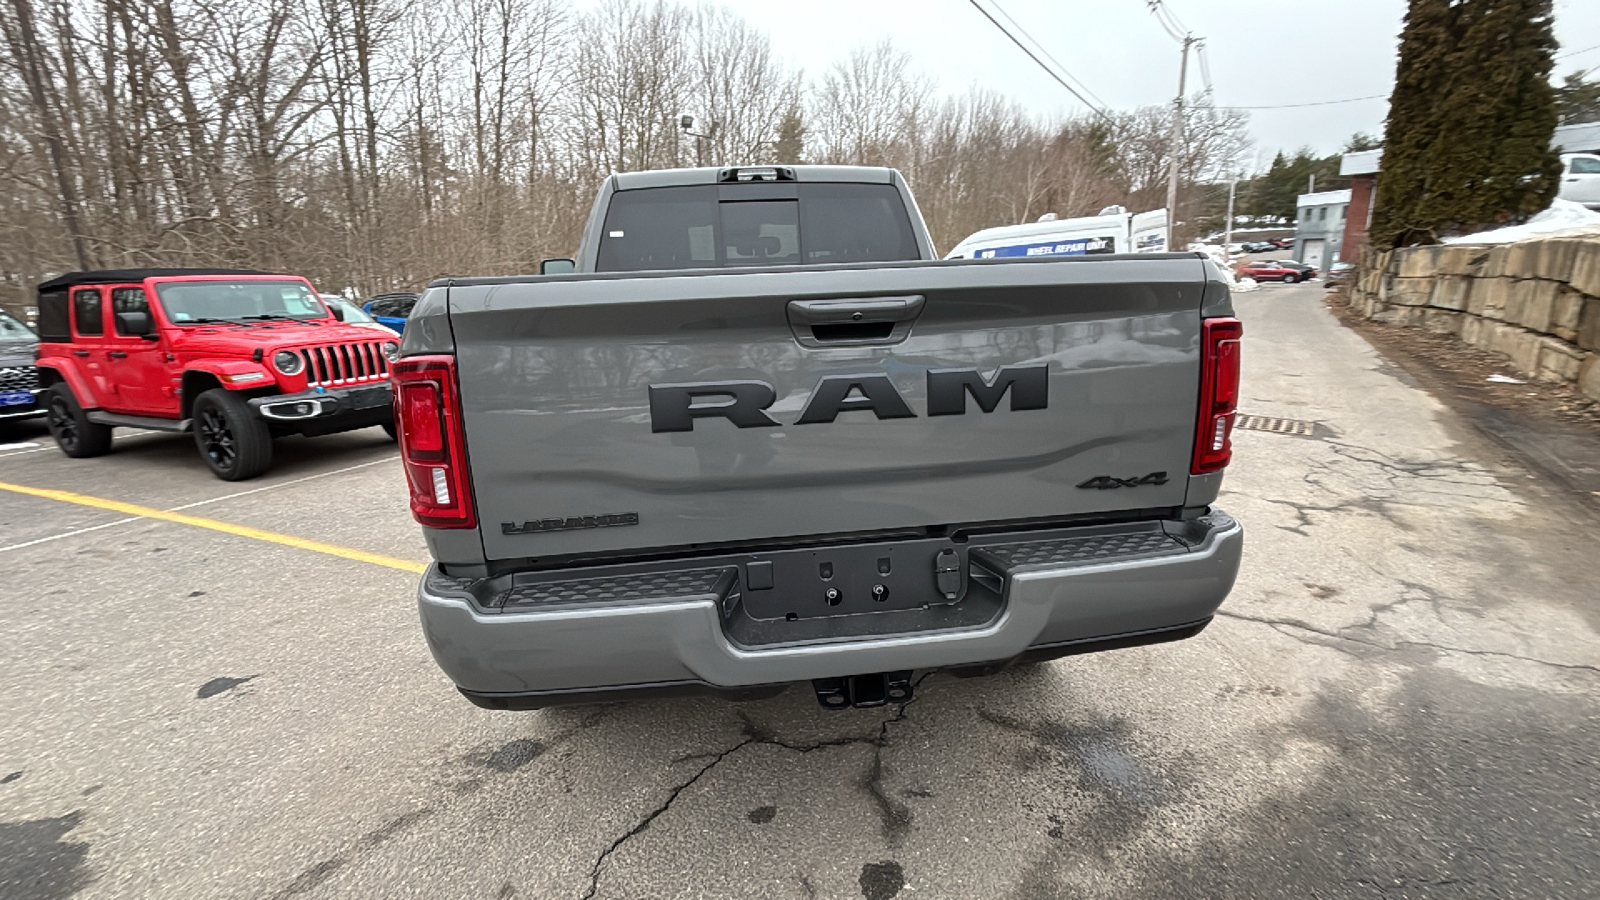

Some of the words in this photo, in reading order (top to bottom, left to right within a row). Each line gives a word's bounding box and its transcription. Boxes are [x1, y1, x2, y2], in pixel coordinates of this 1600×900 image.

[1027, 246, 1054, 256] WHEEL
[1055, 243, 1086, 254] REPAIR
[648, 363, 1049, 434] RAM
